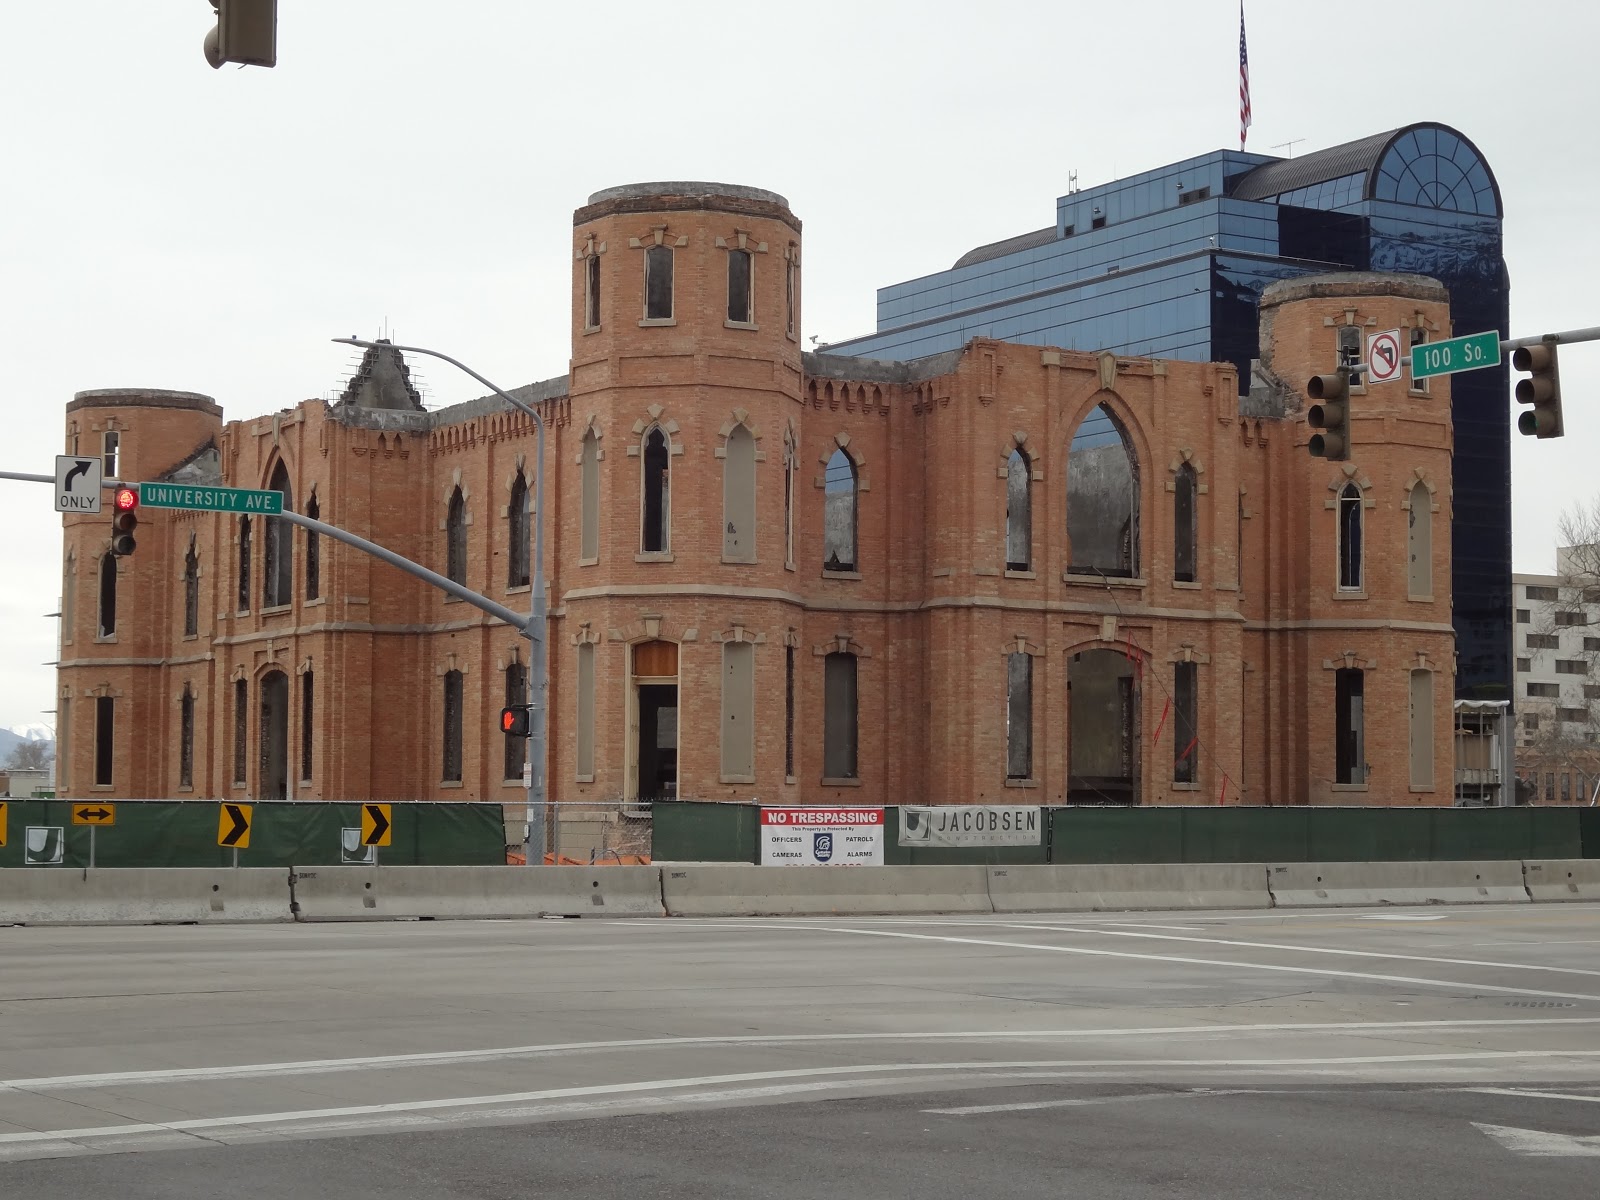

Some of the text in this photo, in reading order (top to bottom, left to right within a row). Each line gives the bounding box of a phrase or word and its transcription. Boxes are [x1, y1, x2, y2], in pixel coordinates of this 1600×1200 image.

[1424, 343, 1487, 370] 100 So.
[60, 495, 95, 509] ONLY
[147, 487, 275, 510] UNIVERSITY AVE.
[768, 812, 878, 823] NO TRESPASSING
[938, 811, 1036, 832] JACOBSEN
